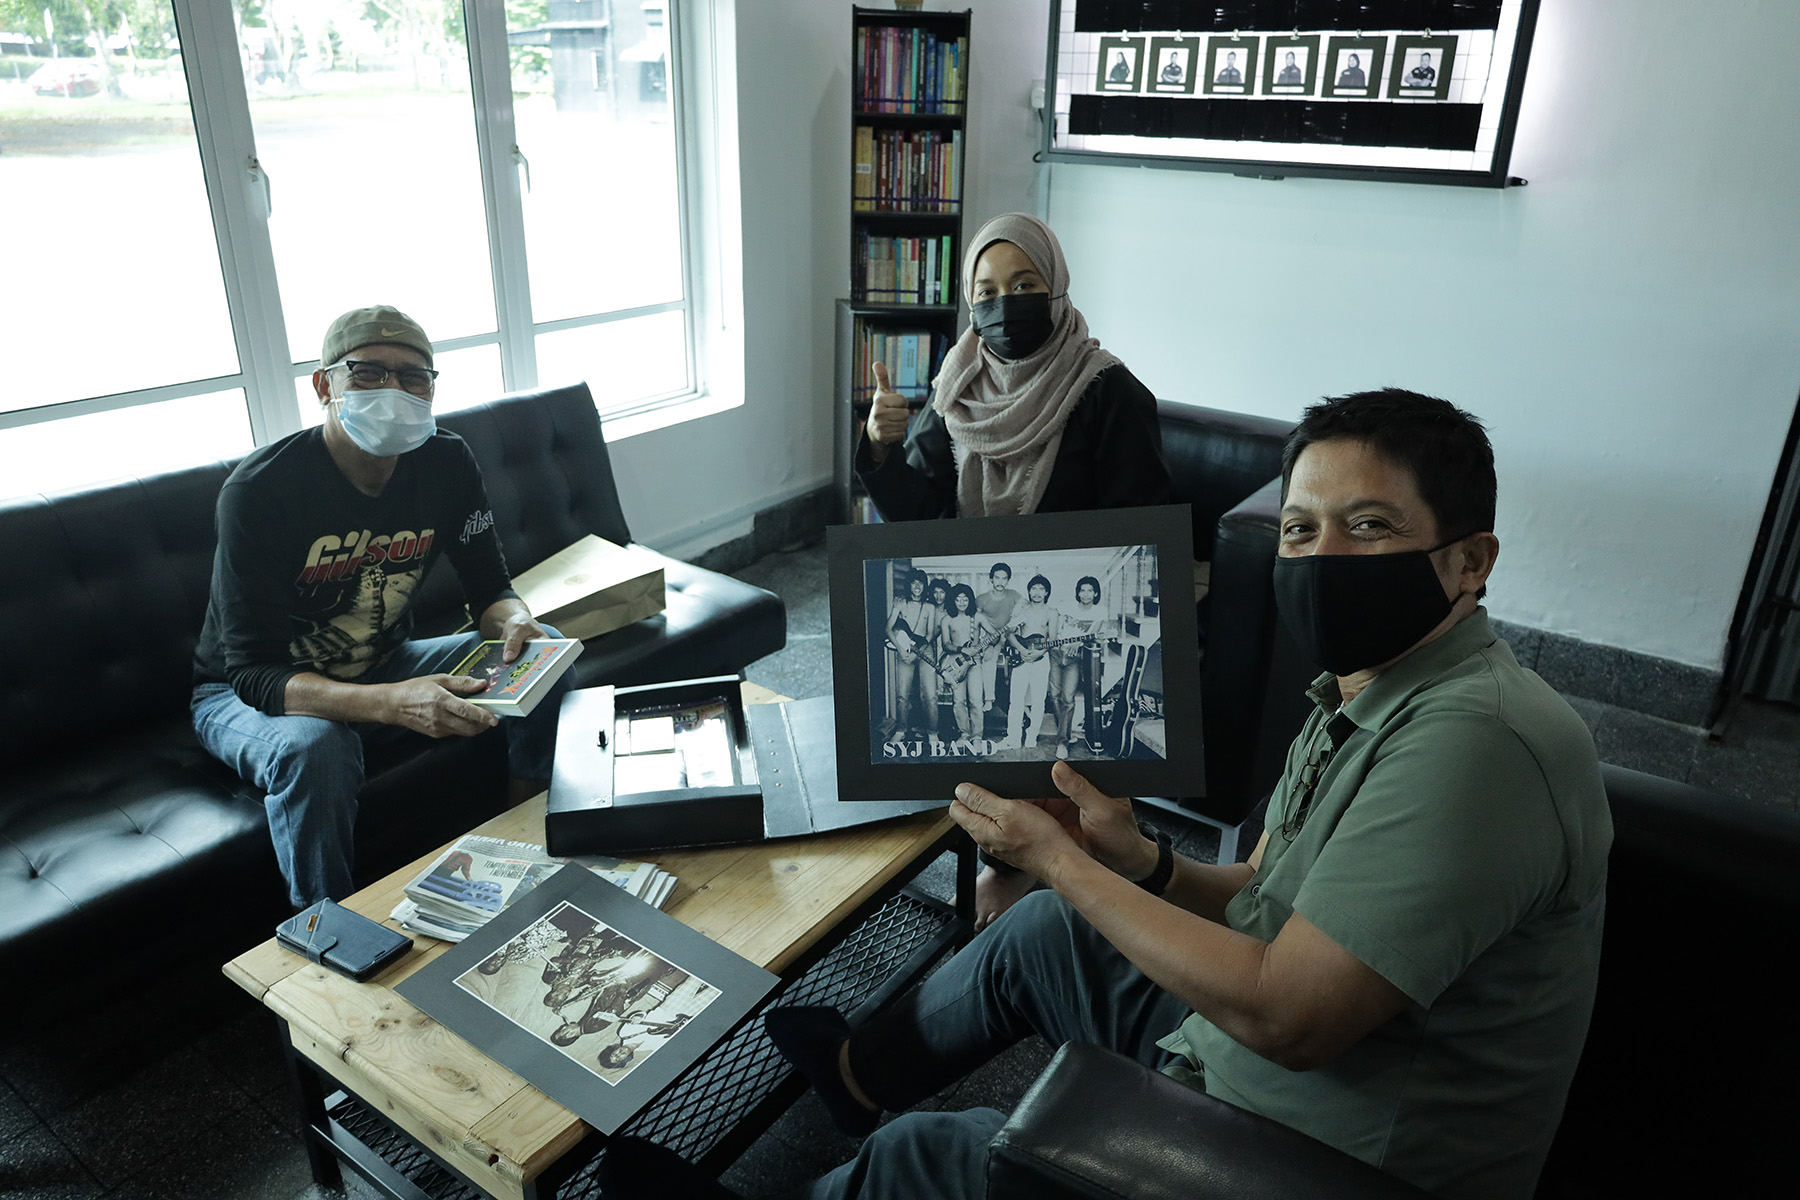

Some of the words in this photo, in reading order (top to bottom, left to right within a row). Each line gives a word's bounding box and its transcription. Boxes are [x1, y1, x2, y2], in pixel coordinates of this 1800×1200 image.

[460, 510, 493, 544] Gibso
[883, 740, 922, 758] SYJ
[930, 740, 998, 757] BAND
